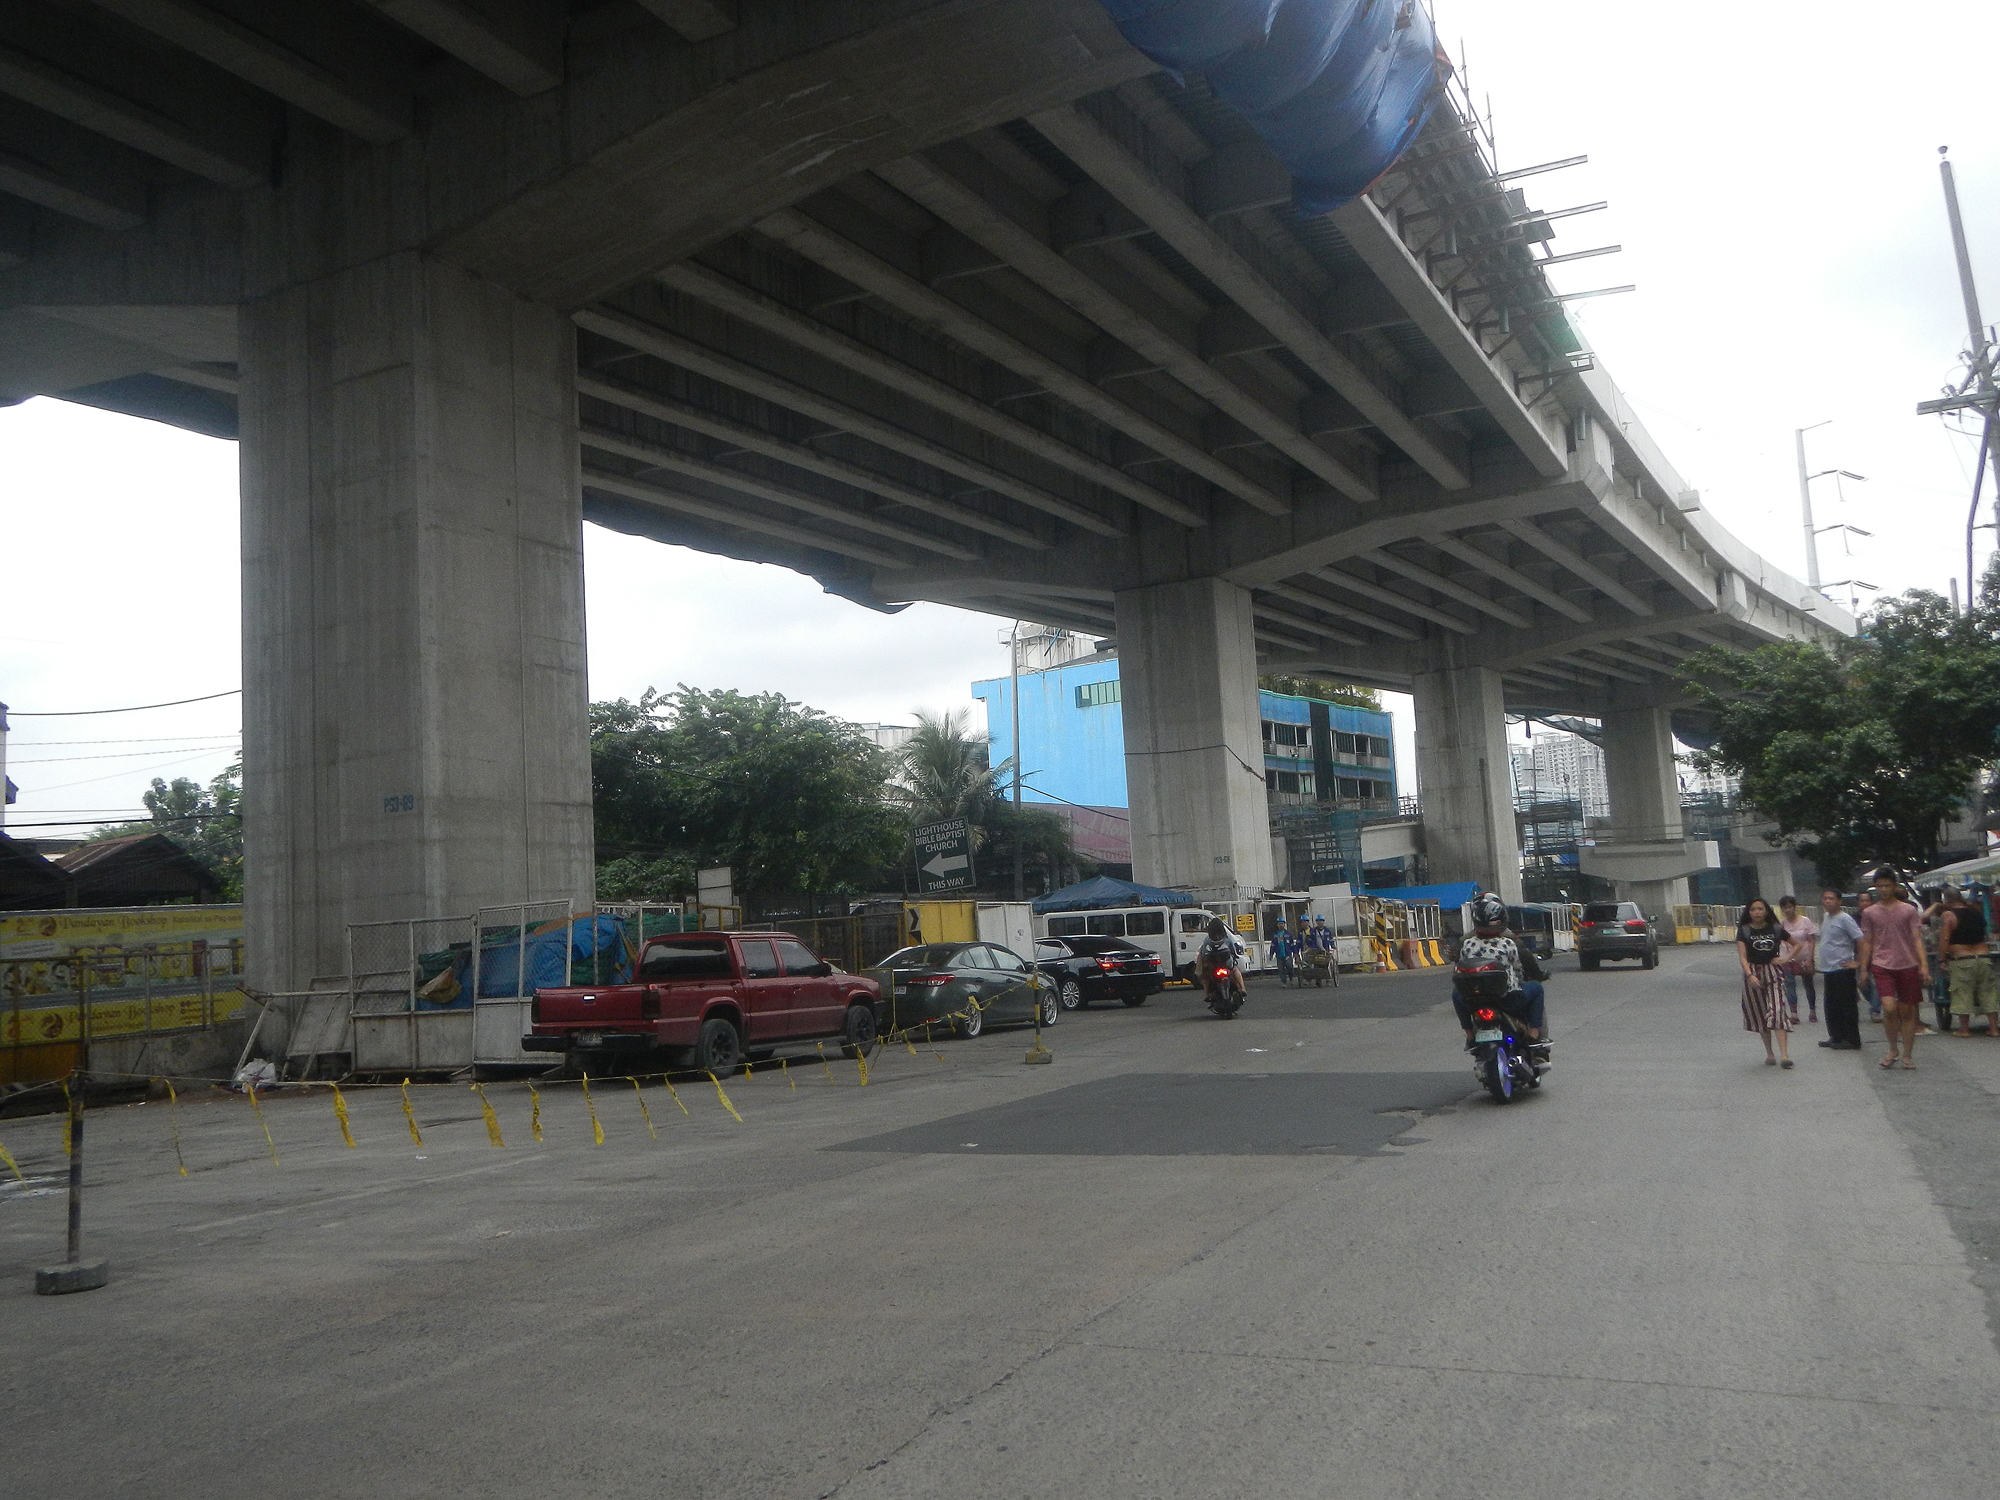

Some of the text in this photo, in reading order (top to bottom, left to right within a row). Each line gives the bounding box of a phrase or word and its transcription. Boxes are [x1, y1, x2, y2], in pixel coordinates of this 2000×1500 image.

[914, 820, 964, 837] LIGHTHOUSE
[915, 829, 966, 846] BIBLE BAPTIST
[925, 840, 958, 853] CHURCH
[1100, 850, 1131, 860] TOYOT
[928, 877, 965, 890] THIS WAY
[120, 914, 168, 930] Bookshop
